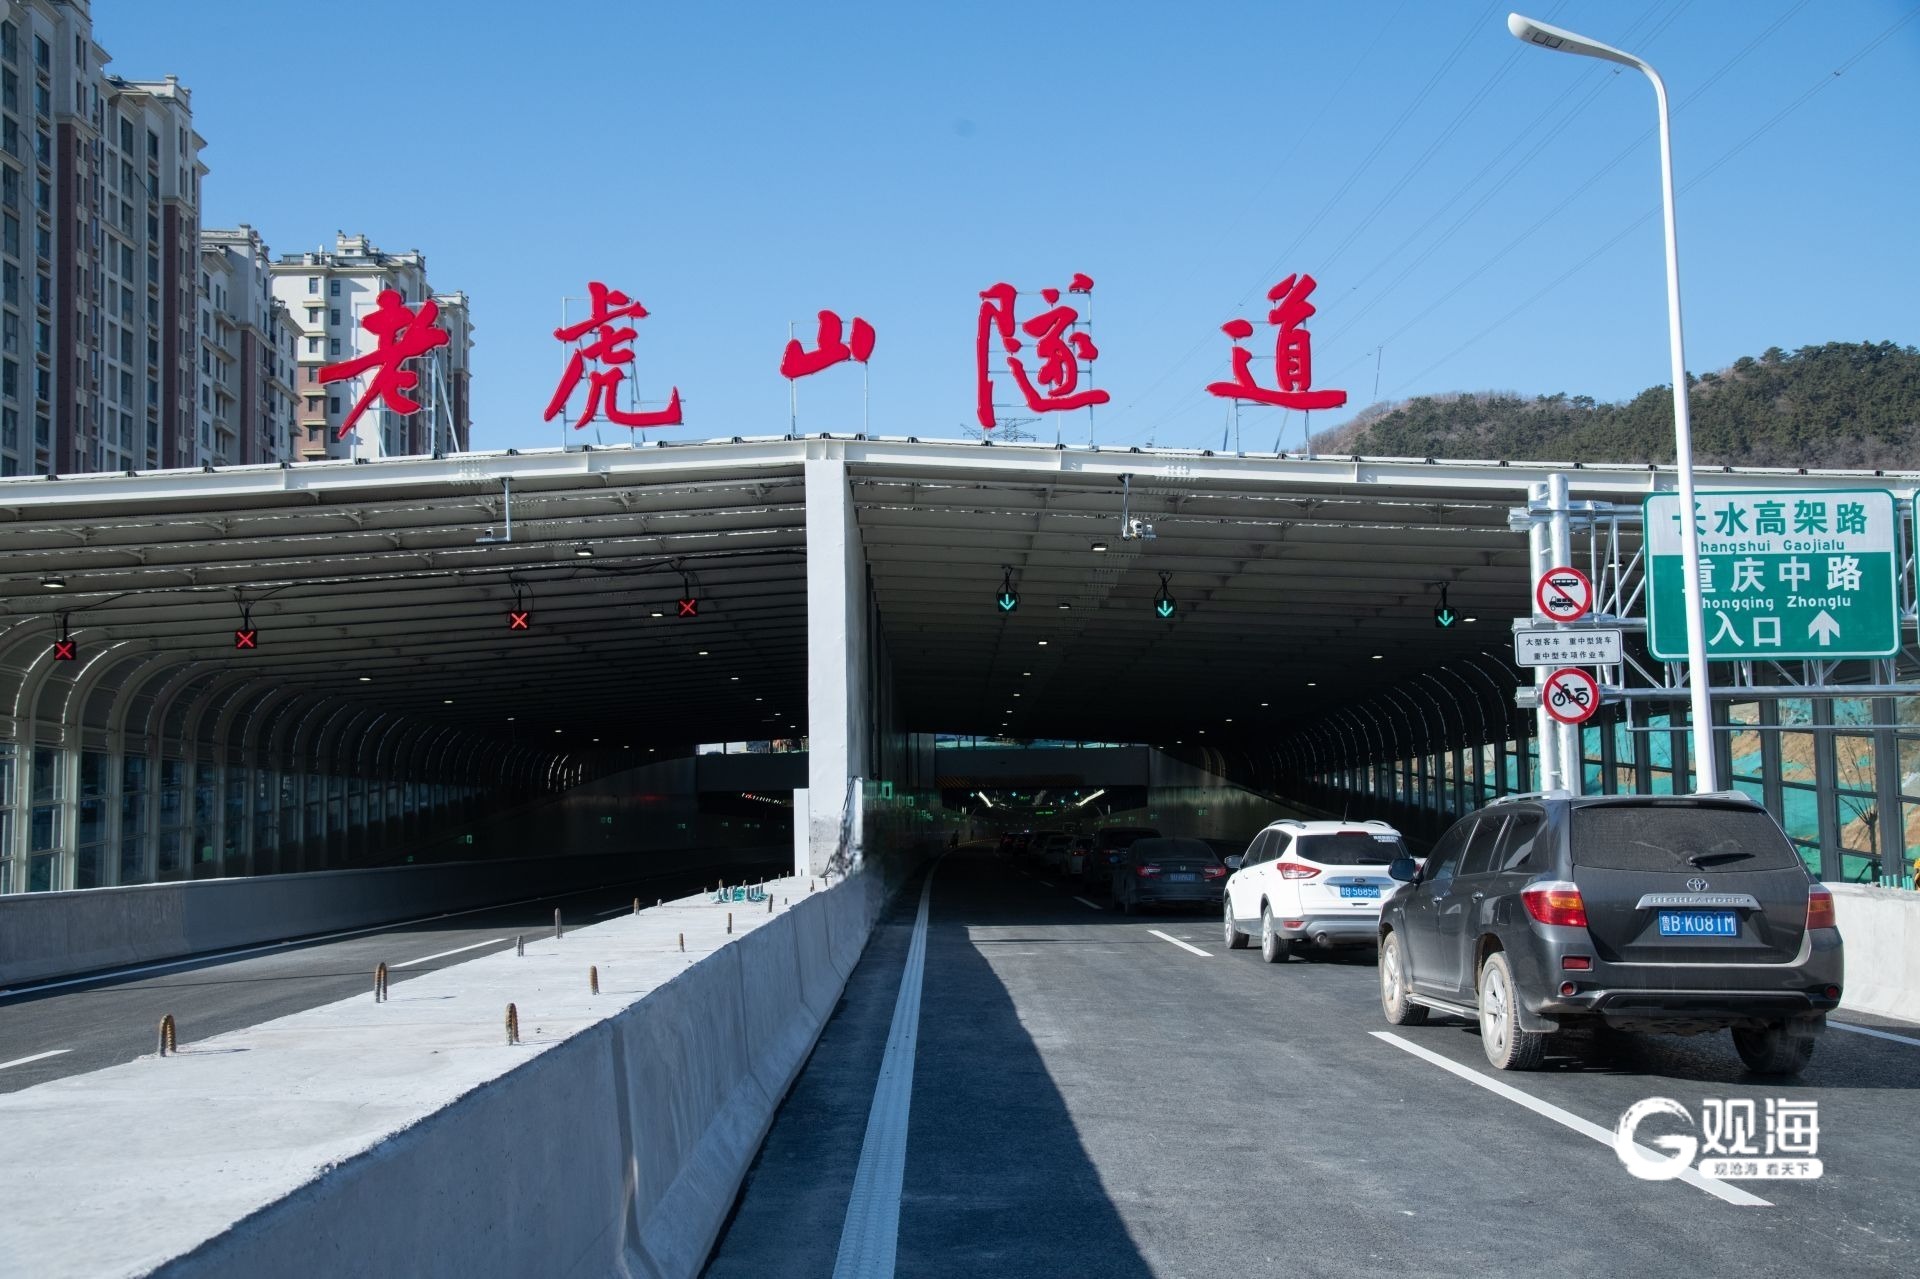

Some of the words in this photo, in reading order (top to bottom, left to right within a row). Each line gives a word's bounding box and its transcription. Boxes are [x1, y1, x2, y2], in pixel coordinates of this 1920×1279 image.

[318, 272, 1346, 437] 老虎山隧道
[1700, 540, 1771, 555] hangshui
[1783, 538, 1846, 553] Gaojialu
[1702, 595, 1775, 612] hongqing
[1786, 594, 1852, 610] Zhonglu
[1708, 610, 1782, 647] 入口
[1526, 638, 1560, 646] 大型客车
[1569, 637, 1612, 645] 重中型货车
[1534, 651, 1606, 660] 重中型专项作业车
